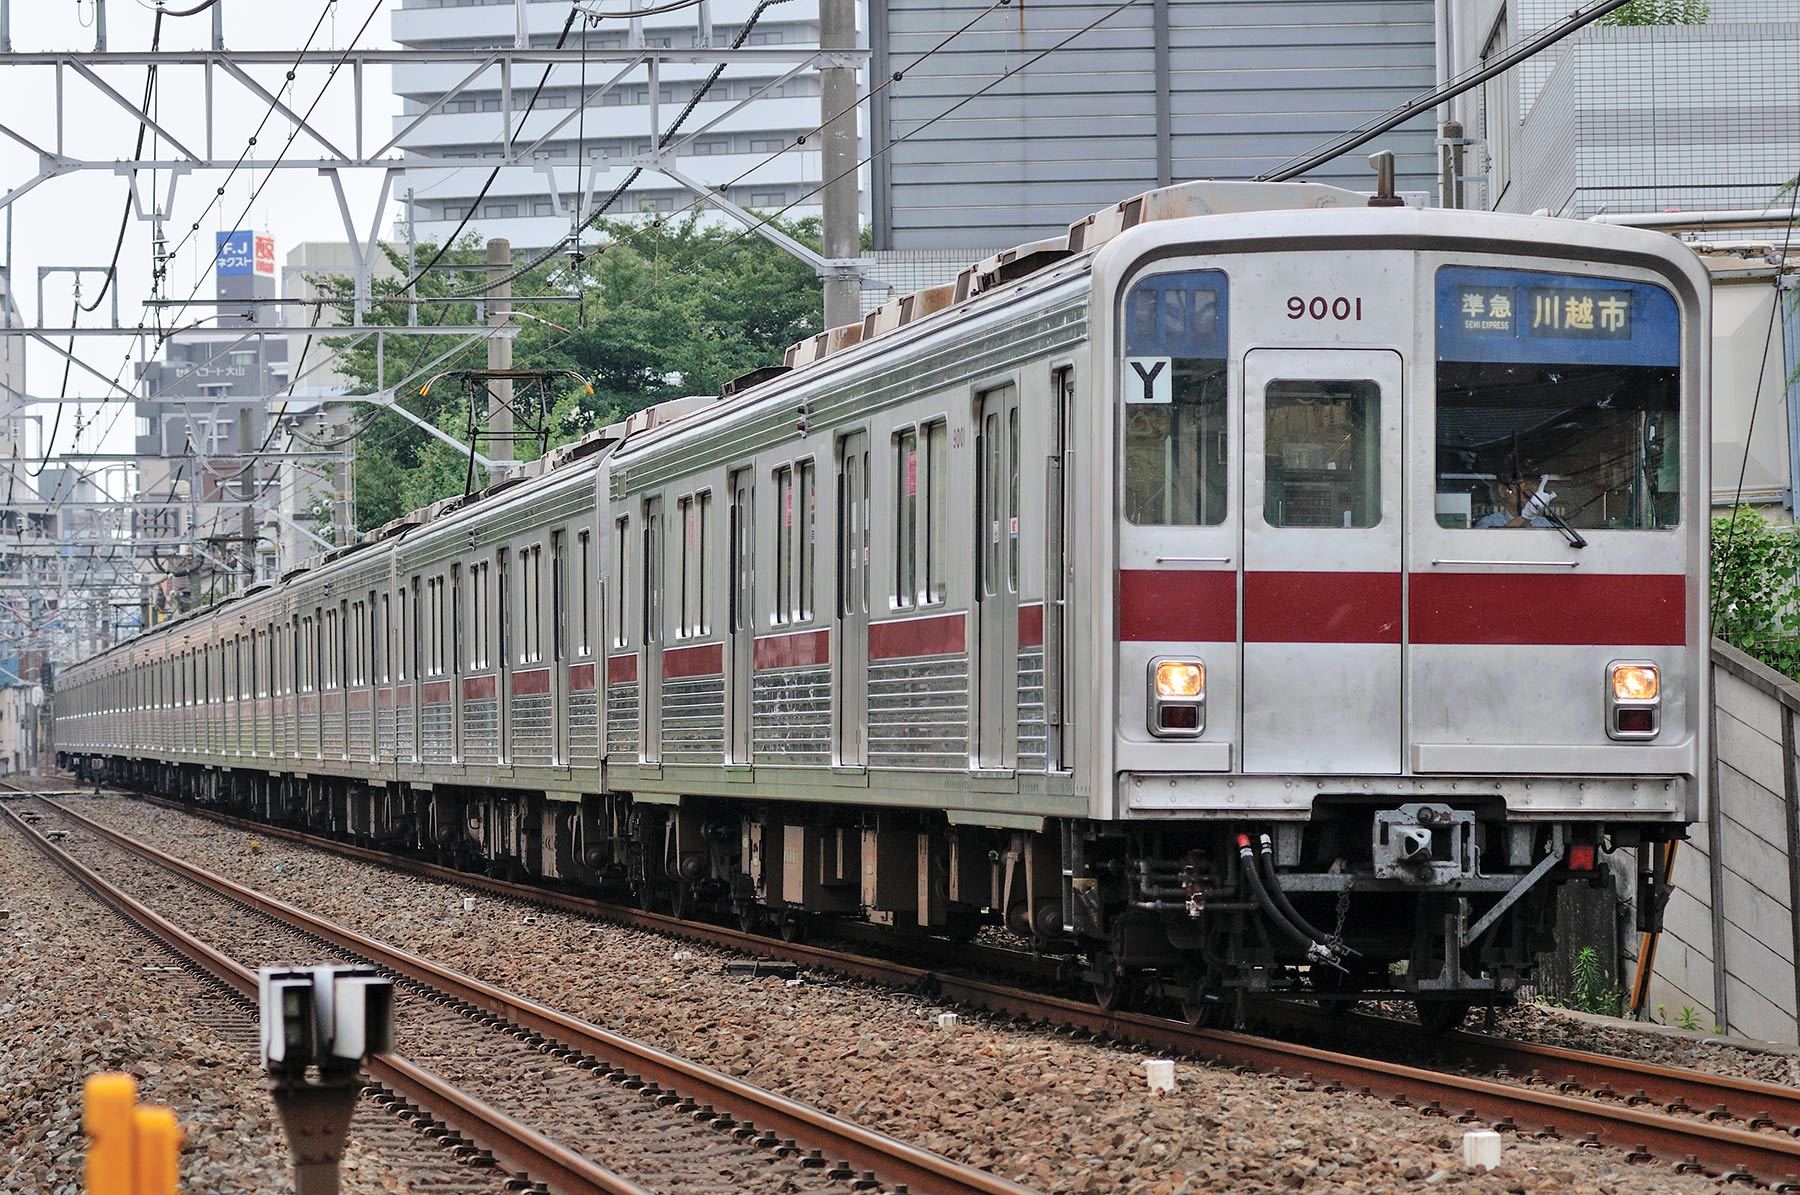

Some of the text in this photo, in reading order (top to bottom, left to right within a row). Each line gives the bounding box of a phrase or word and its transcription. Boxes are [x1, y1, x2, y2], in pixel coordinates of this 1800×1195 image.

[222, 241, 248, 255] F.J
[217, 256, 252, 269] ネクスト
[1286, 296, 1361, 321] 9001
[1462, 293, 1511, 318] 準急
[1533, 295, 1627, 332] 川越市
[1464, 320, 1509, 330] SEMI EXPRESS
[1130, 361, 1167, 399] Y
